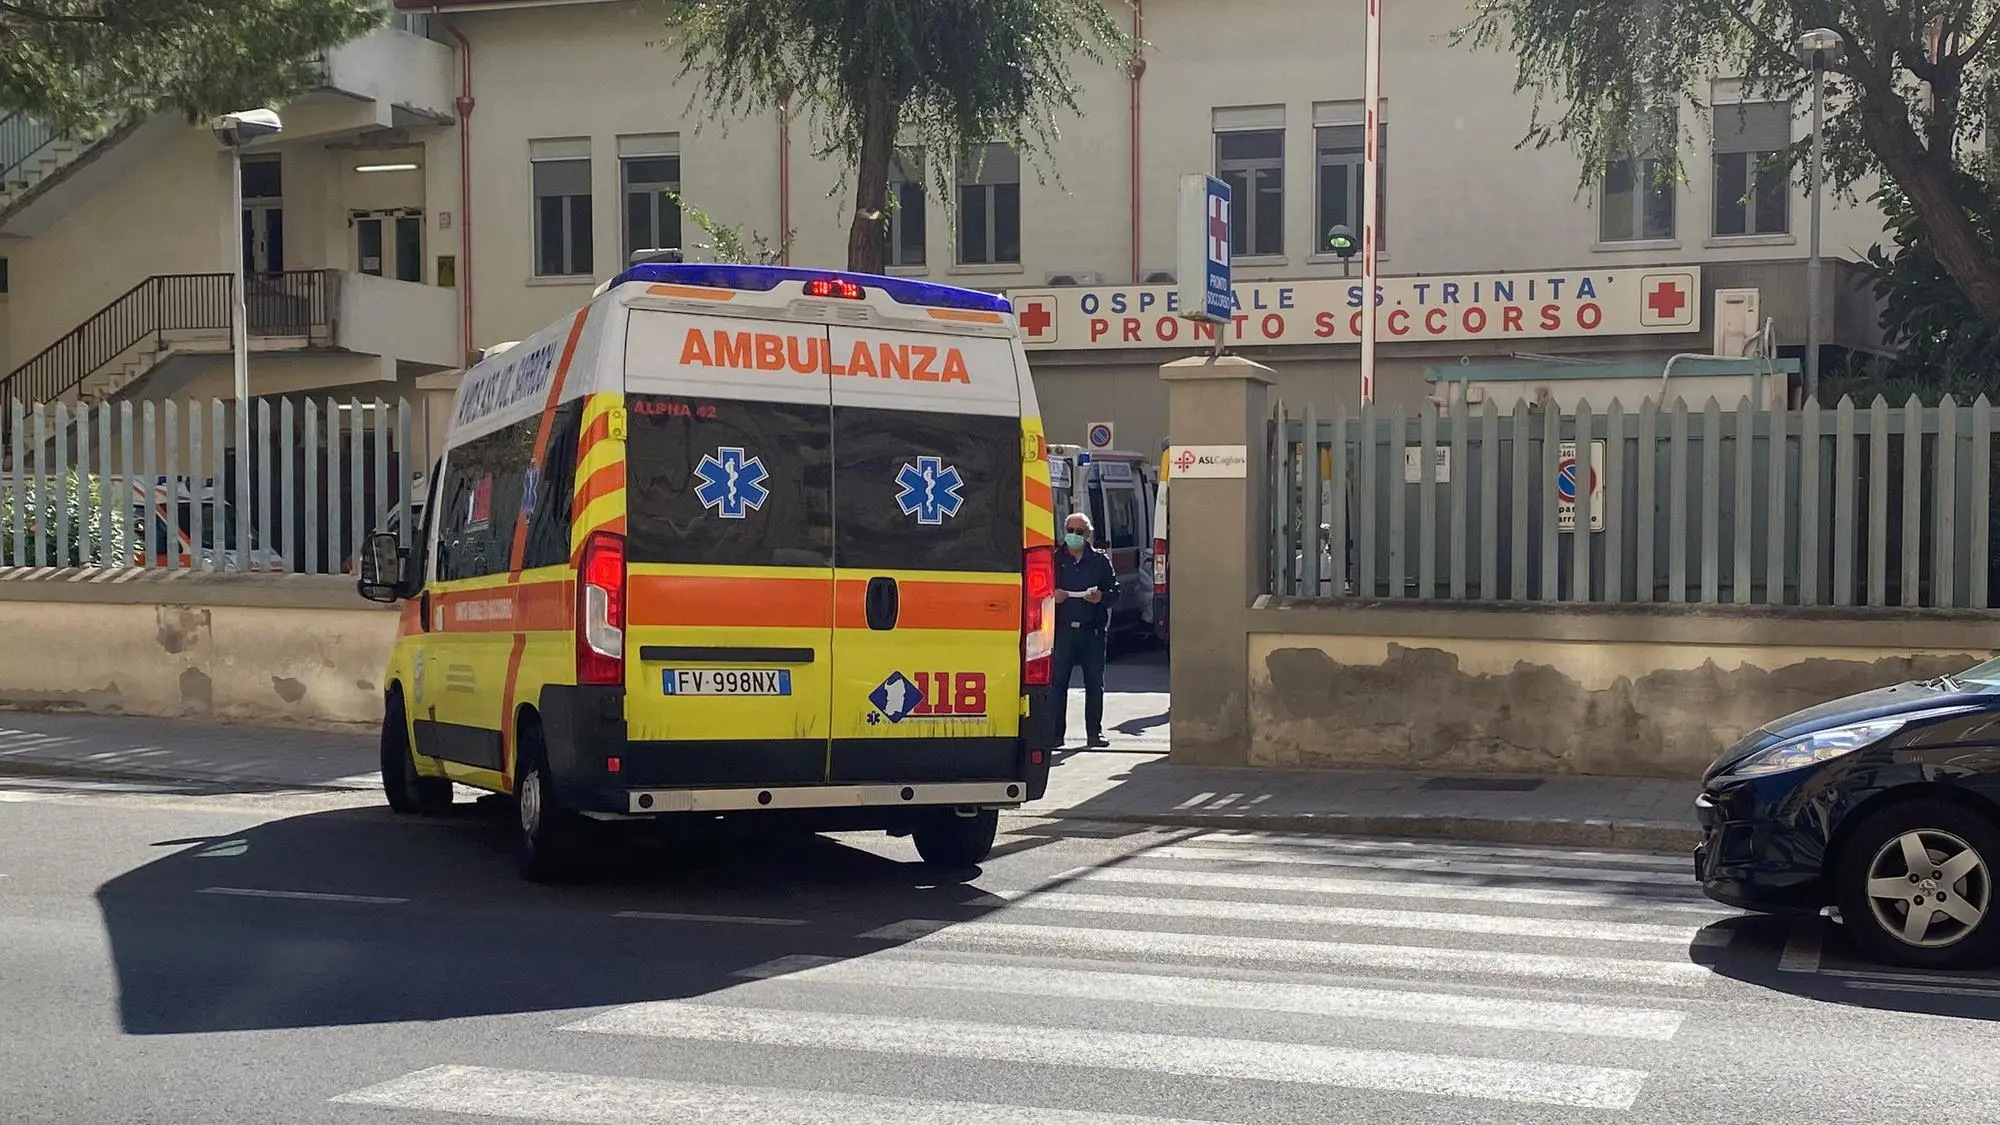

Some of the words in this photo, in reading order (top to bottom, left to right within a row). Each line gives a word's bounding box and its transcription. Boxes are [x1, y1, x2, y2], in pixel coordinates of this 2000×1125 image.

[1080, 288, 1294, 314] OSPEALE
[1090, 313, 1285, 343] PRONTO
[679, 328, 971, 384] AMBULANZA
[634, 400, 692, 417] ALPHA
[678, 672, 703, 692] FV
[713, 672, 778, 692] 998NX
[913, 672, 987, 713] 118
